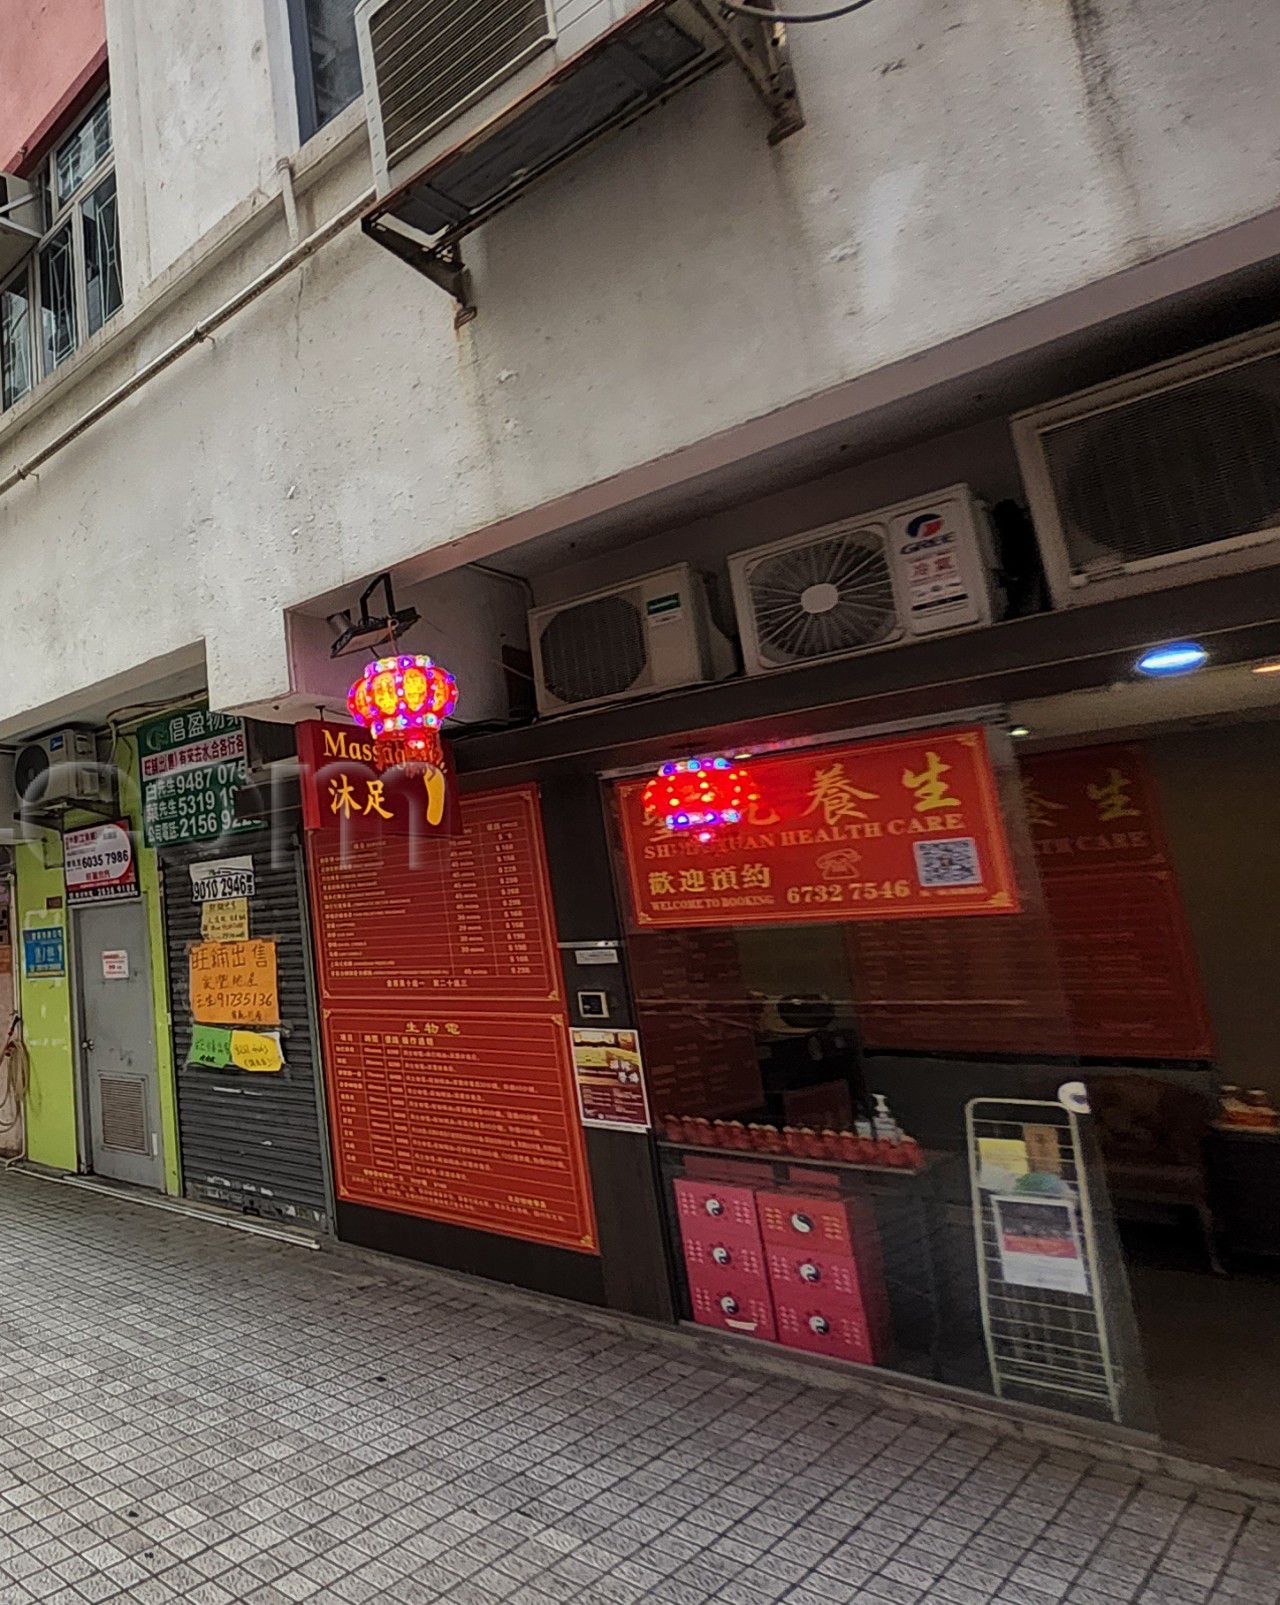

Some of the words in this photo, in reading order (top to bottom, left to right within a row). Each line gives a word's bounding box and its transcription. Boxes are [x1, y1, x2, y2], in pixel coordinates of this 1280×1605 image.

[176, 767, 213, 795] 9487
[217, 760, 247, 785] 075
[178, 790, 216, 817] 5319
[328, 774, 394, 819] 沐足
[180, 812, 217, 838] 2156
[780, 822, 883, 846] HEALTH
[887, 813, 966, 836] CARE
[82, 854, 104, 869] 6035
[106, 849, 129, 865] 7986
[193, 880, 218, 899] 9010
[221, 874, 247, 897] 2946
[648, 863, 771, 895] 歡迎預約
[786, 884, 843, 904] 6732
[848, 879, 910, 900] 7546
[405, 1021, 461, 1035] 生物電
